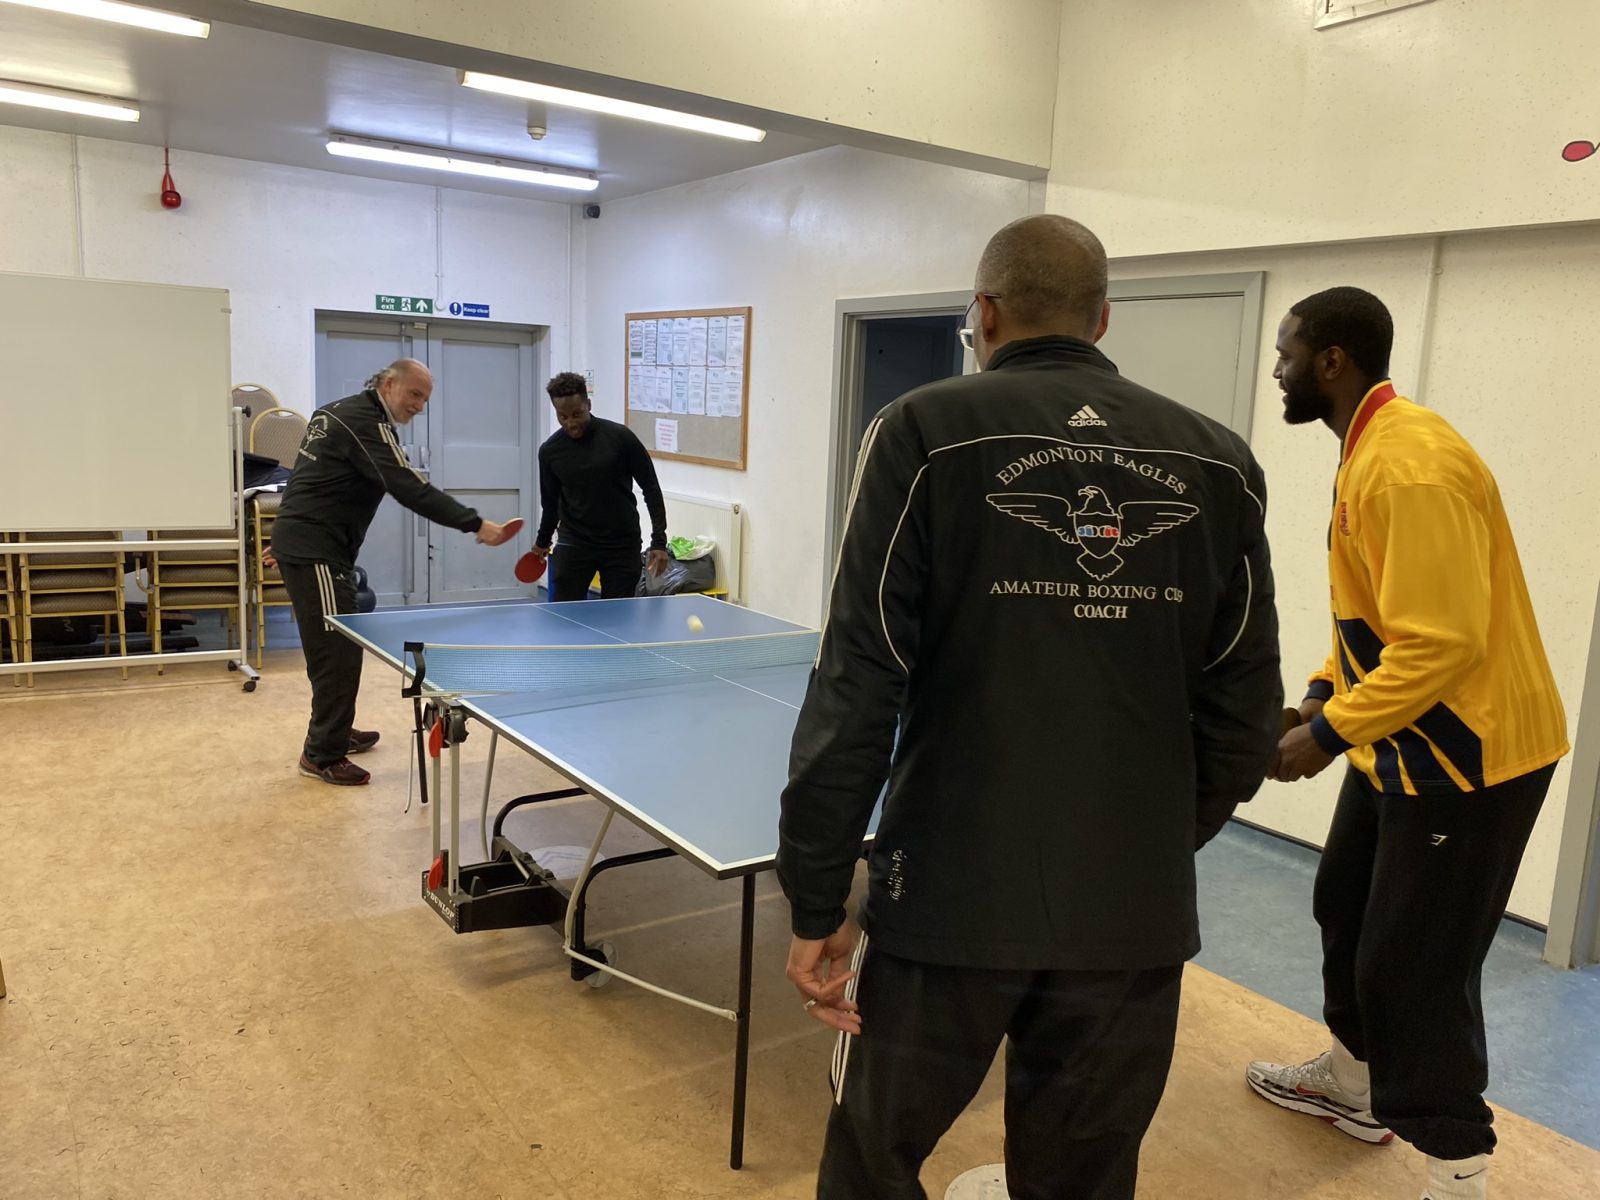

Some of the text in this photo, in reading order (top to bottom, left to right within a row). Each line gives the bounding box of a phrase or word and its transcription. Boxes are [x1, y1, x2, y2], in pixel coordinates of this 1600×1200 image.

[381, 296, 396, 304] Fire
[1067, 418, 1108, 427] adidas
[996, 447, 1187, 494] EDMONTON EAGLES
[989, 581, 1081, 597] AMATEUR
[1087, 585, 1157, 600] BOXING
[1073, 604, 1128, 619] COACH
